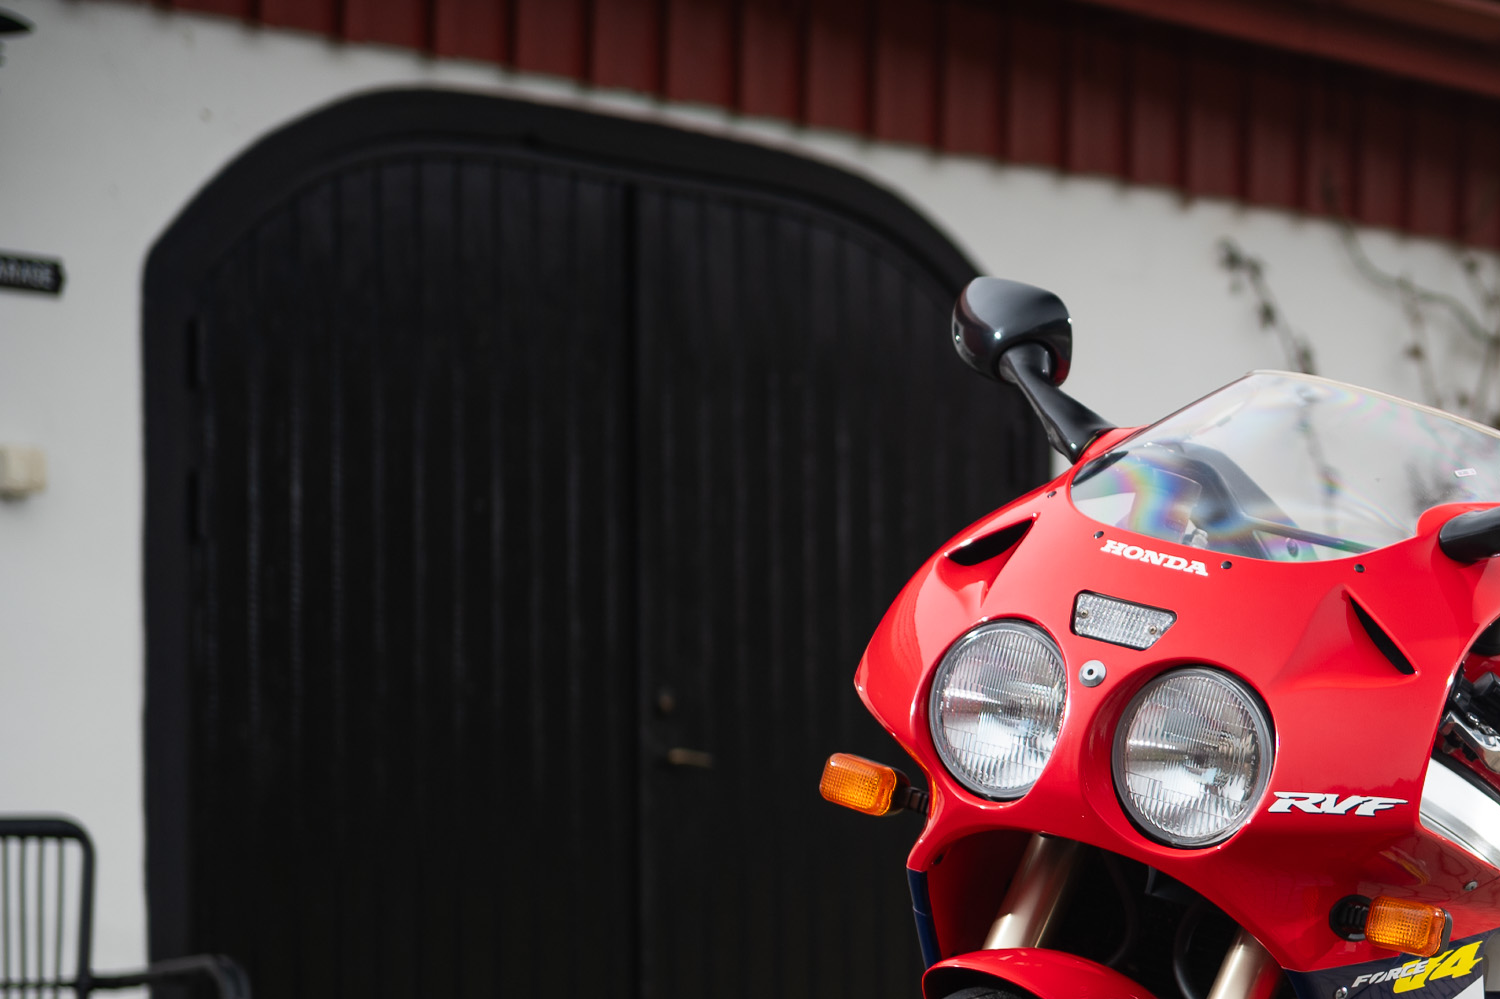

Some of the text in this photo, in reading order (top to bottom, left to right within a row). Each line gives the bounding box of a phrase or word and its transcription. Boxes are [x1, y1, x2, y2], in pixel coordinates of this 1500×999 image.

[1100, 539, 1208, 577] HONDA
[1268, 791, 1408, 817] RVF
[1351, 960, 1429, 988] FORCE
